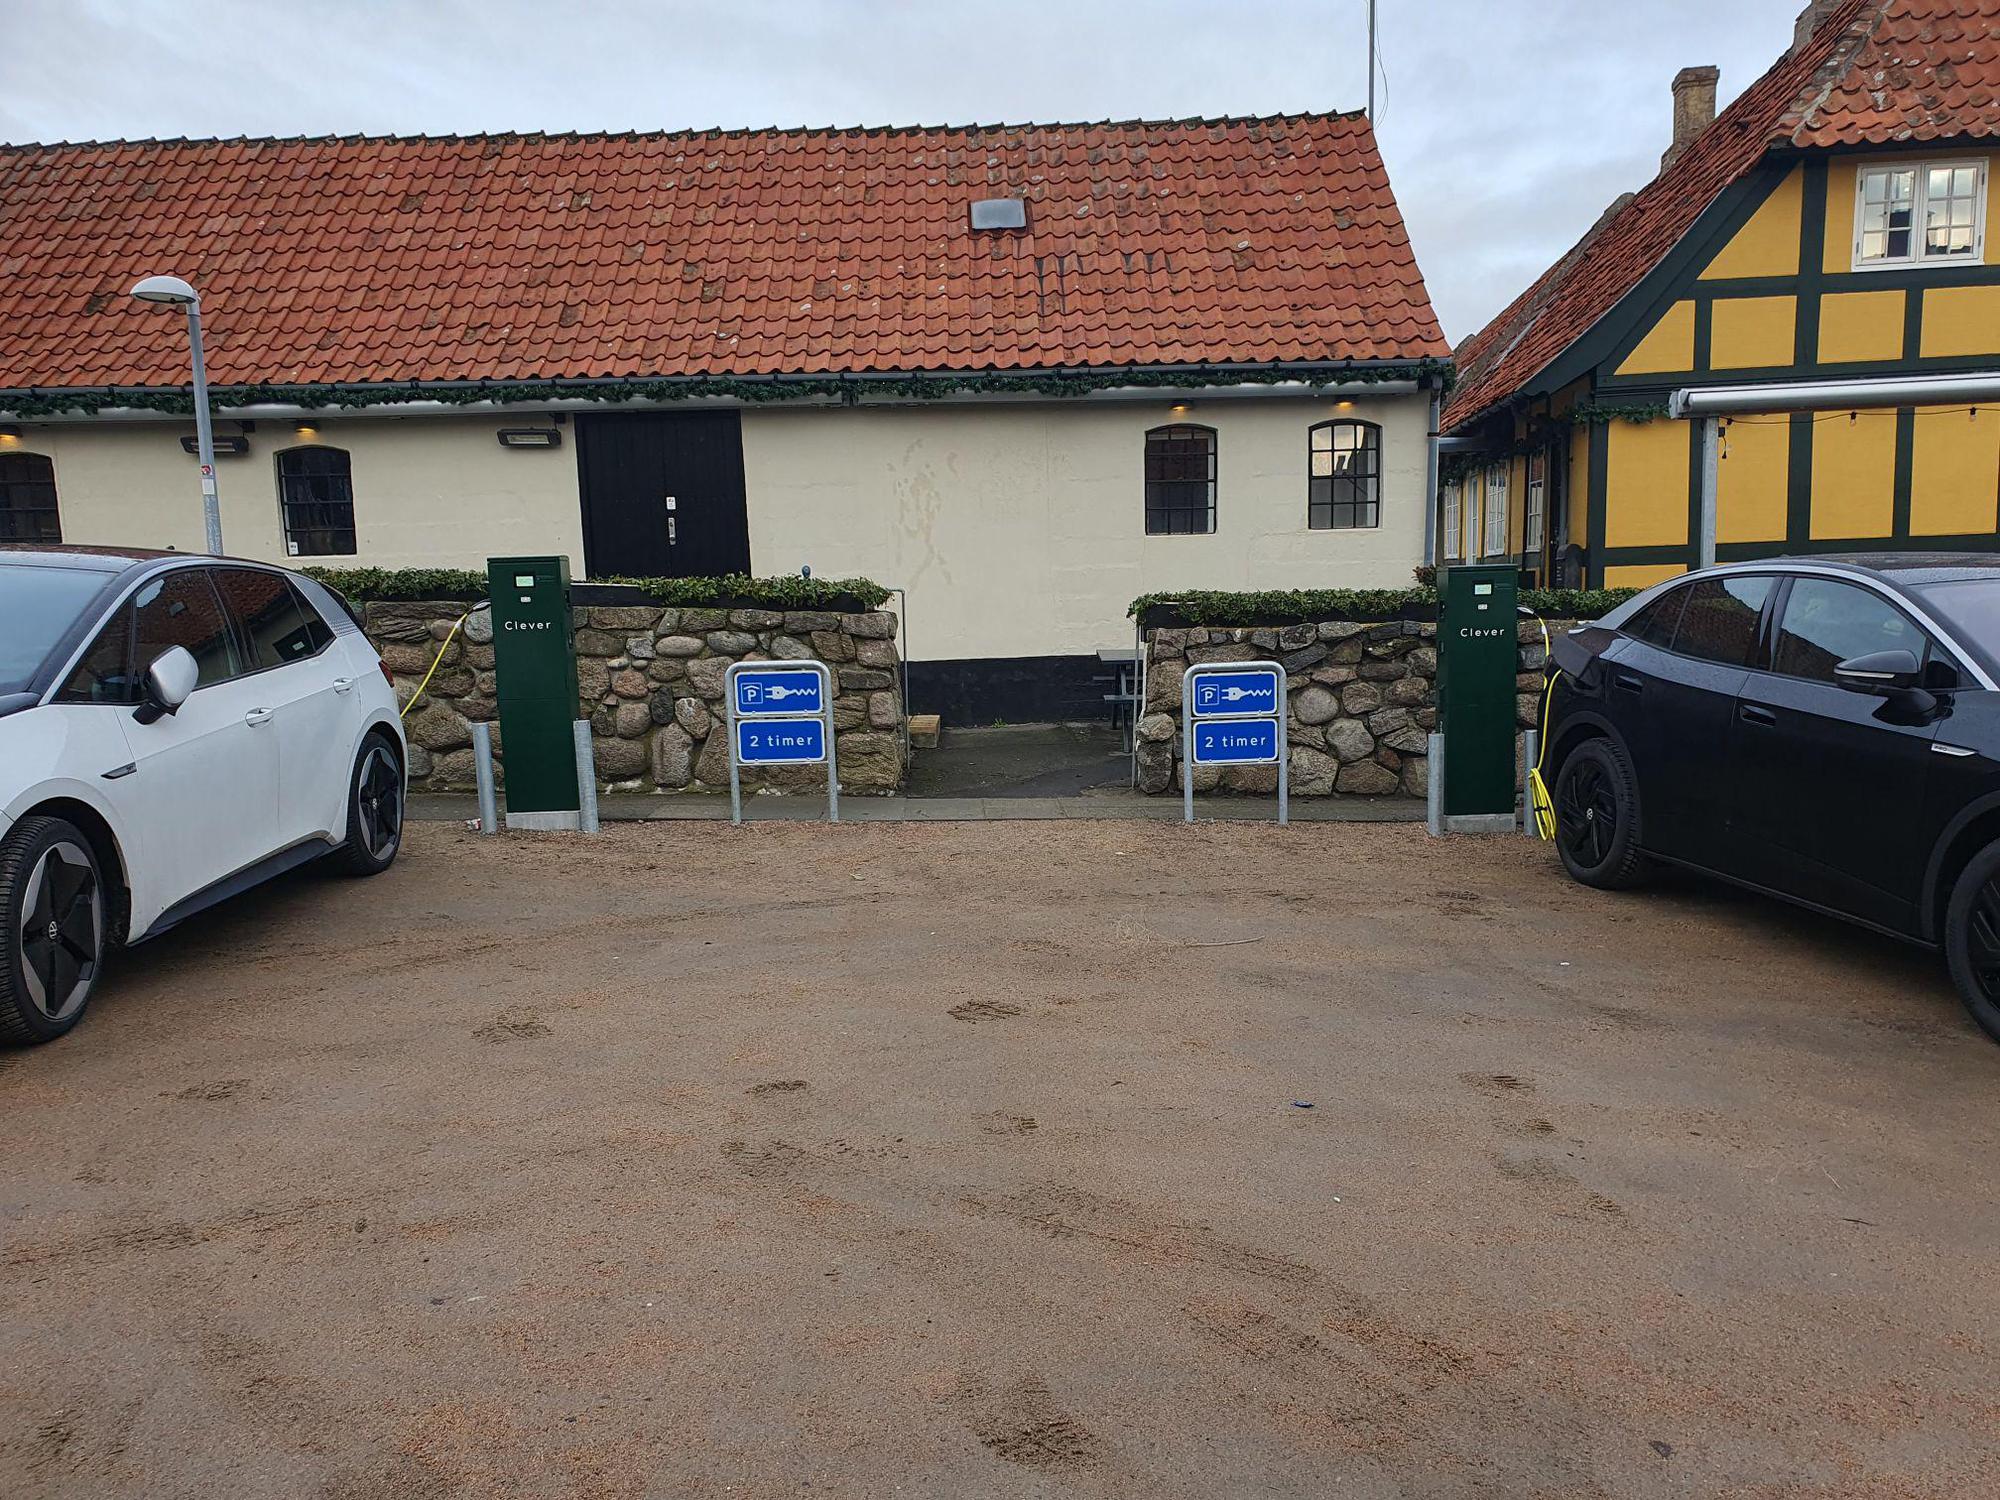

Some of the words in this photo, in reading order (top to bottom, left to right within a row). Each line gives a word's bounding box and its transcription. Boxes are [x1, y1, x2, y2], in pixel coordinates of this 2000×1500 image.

[505, 621, 551, 631] Clever
[1460, 628, 1505, 637] Clever
[747, 689, 757, 702] P
[1204, 691, 1213, 703] P
[750, 736, 759, 747] 2
[767, 735, 813, 747] timer
[1205, 736, 1213, 748] 2
[1222, 735, 1266, 747] timer
